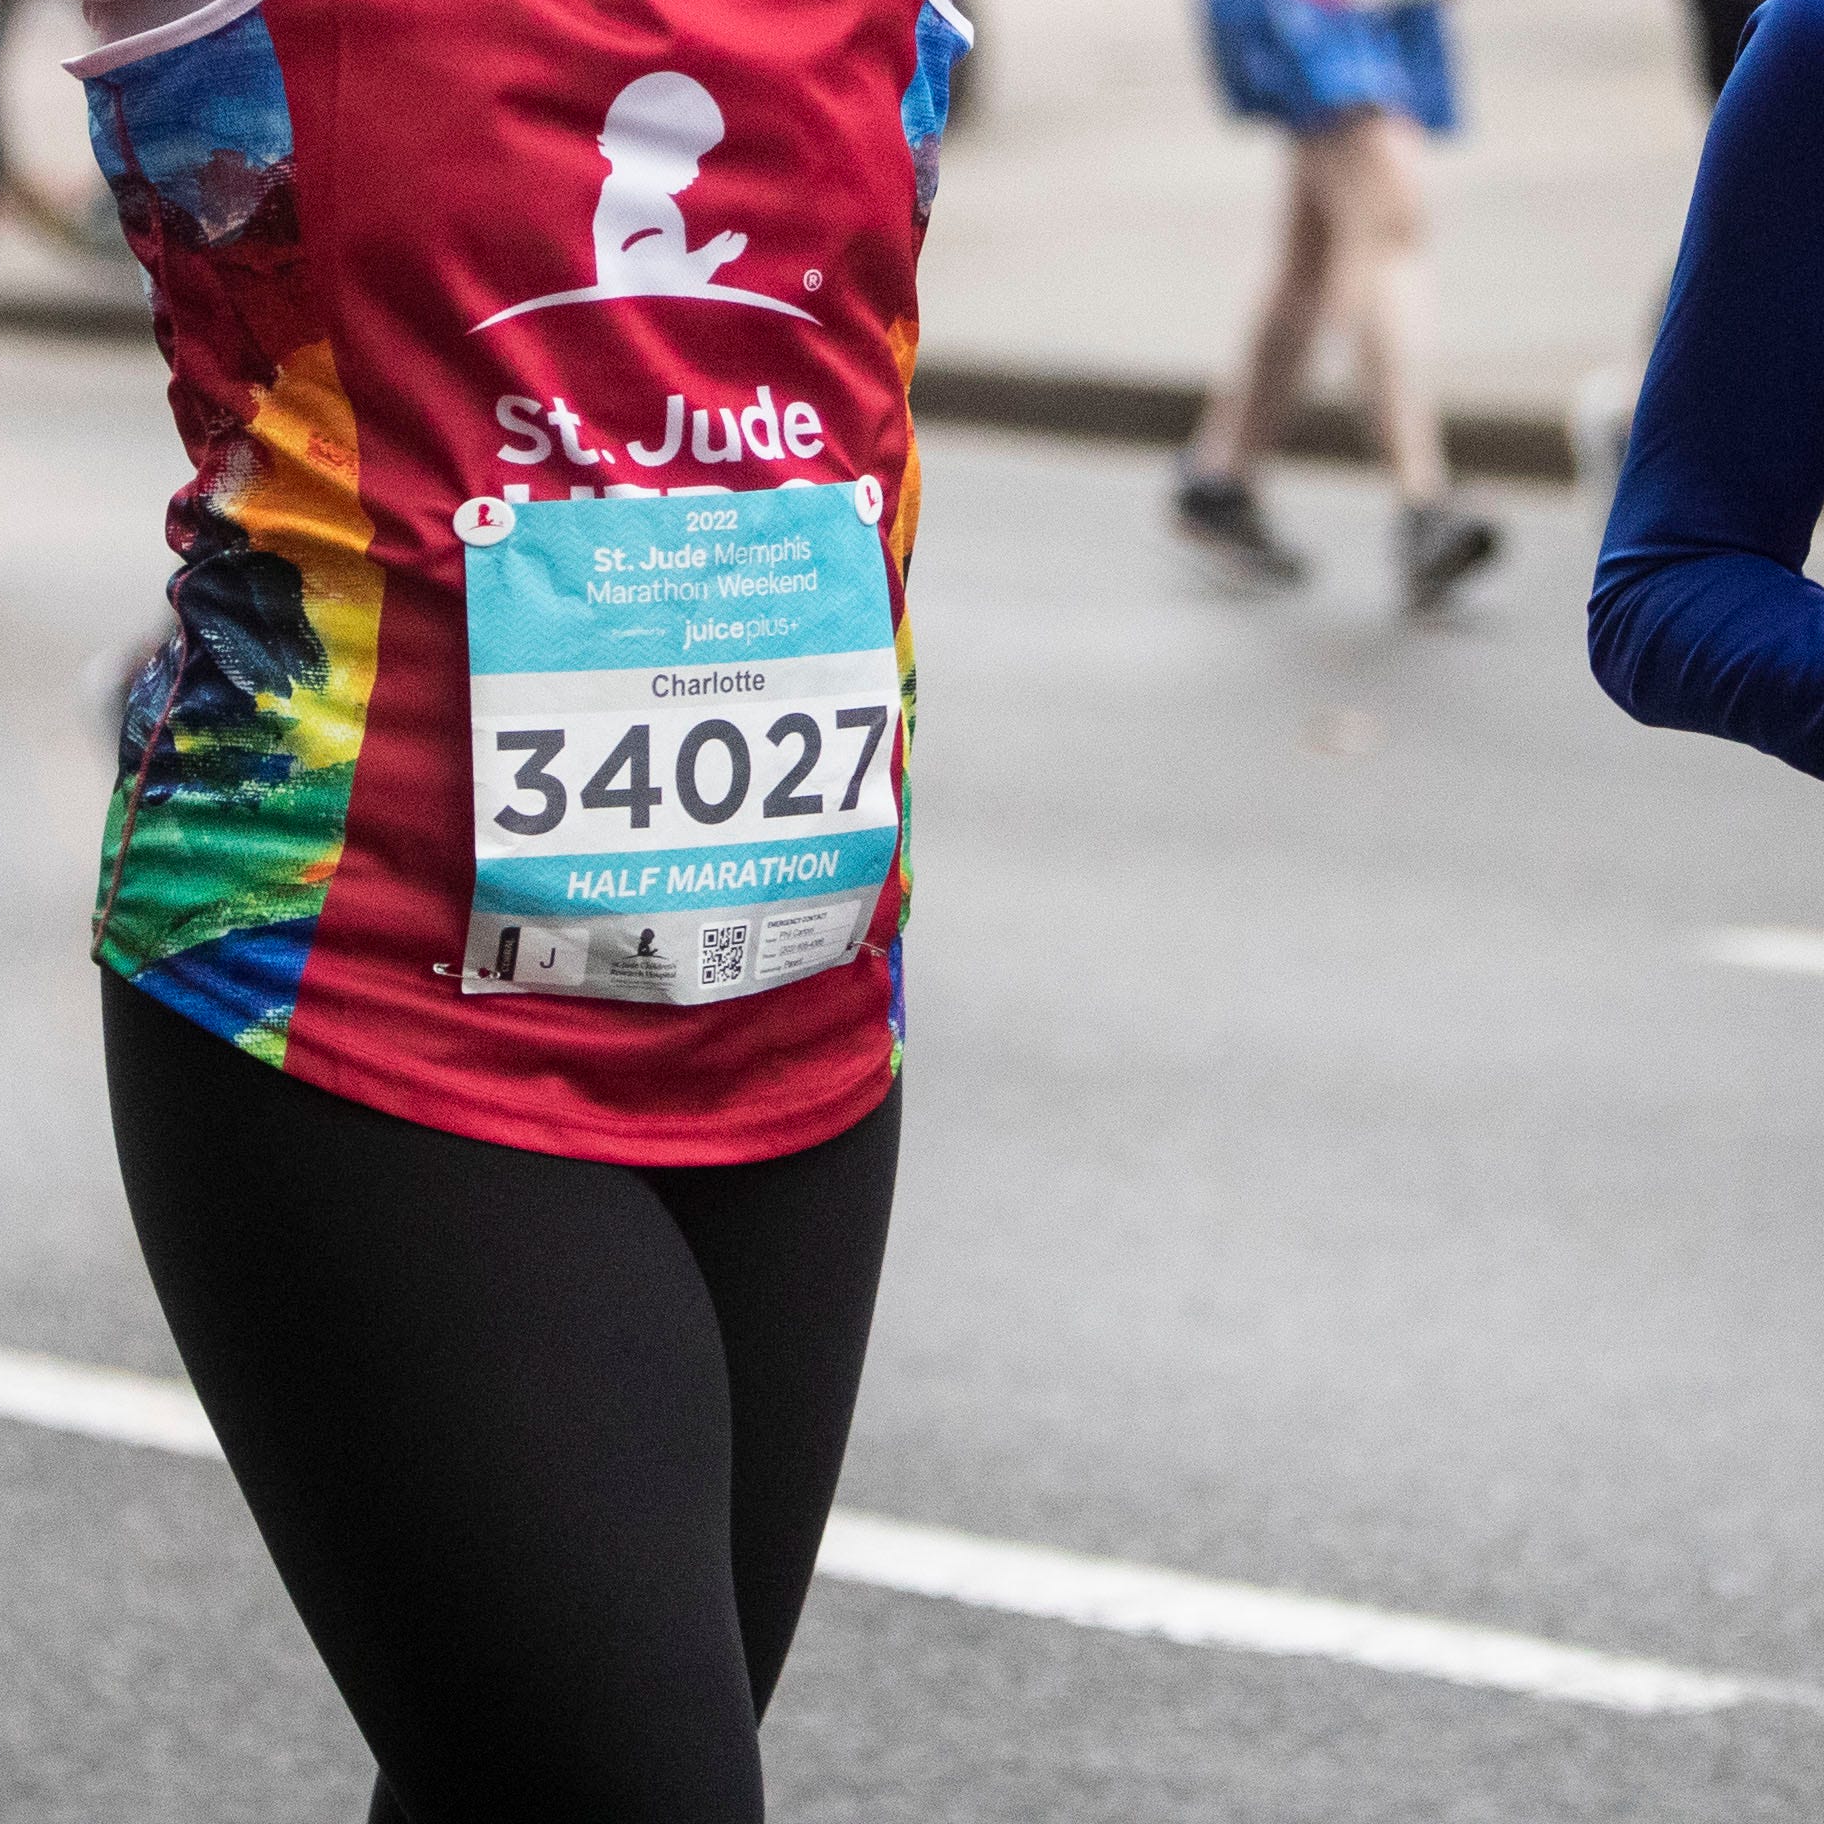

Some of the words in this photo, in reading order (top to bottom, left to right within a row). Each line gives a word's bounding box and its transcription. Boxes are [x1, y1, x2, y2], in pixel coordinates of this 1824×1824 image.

[496, 394, 616, 466] St.
[626, 385, 826, 467] Jude
[686, 509, 738, 532] 2022
[593, 547, 635, 573] St.
[639, 543, 707, 571] Jude
[714, 535, 812, 568] Memphis
[586, 577, 709, 605] Marathon
[717, 567, 818, 598] Weekend
[651, 669, 766, 699] Charlotte
[493, 705, 888, 836] 34027
[567, 863, 662, 900] HALF
[666, 850, 840, 893] MARATHON
[539, 947, 556, 969] J
